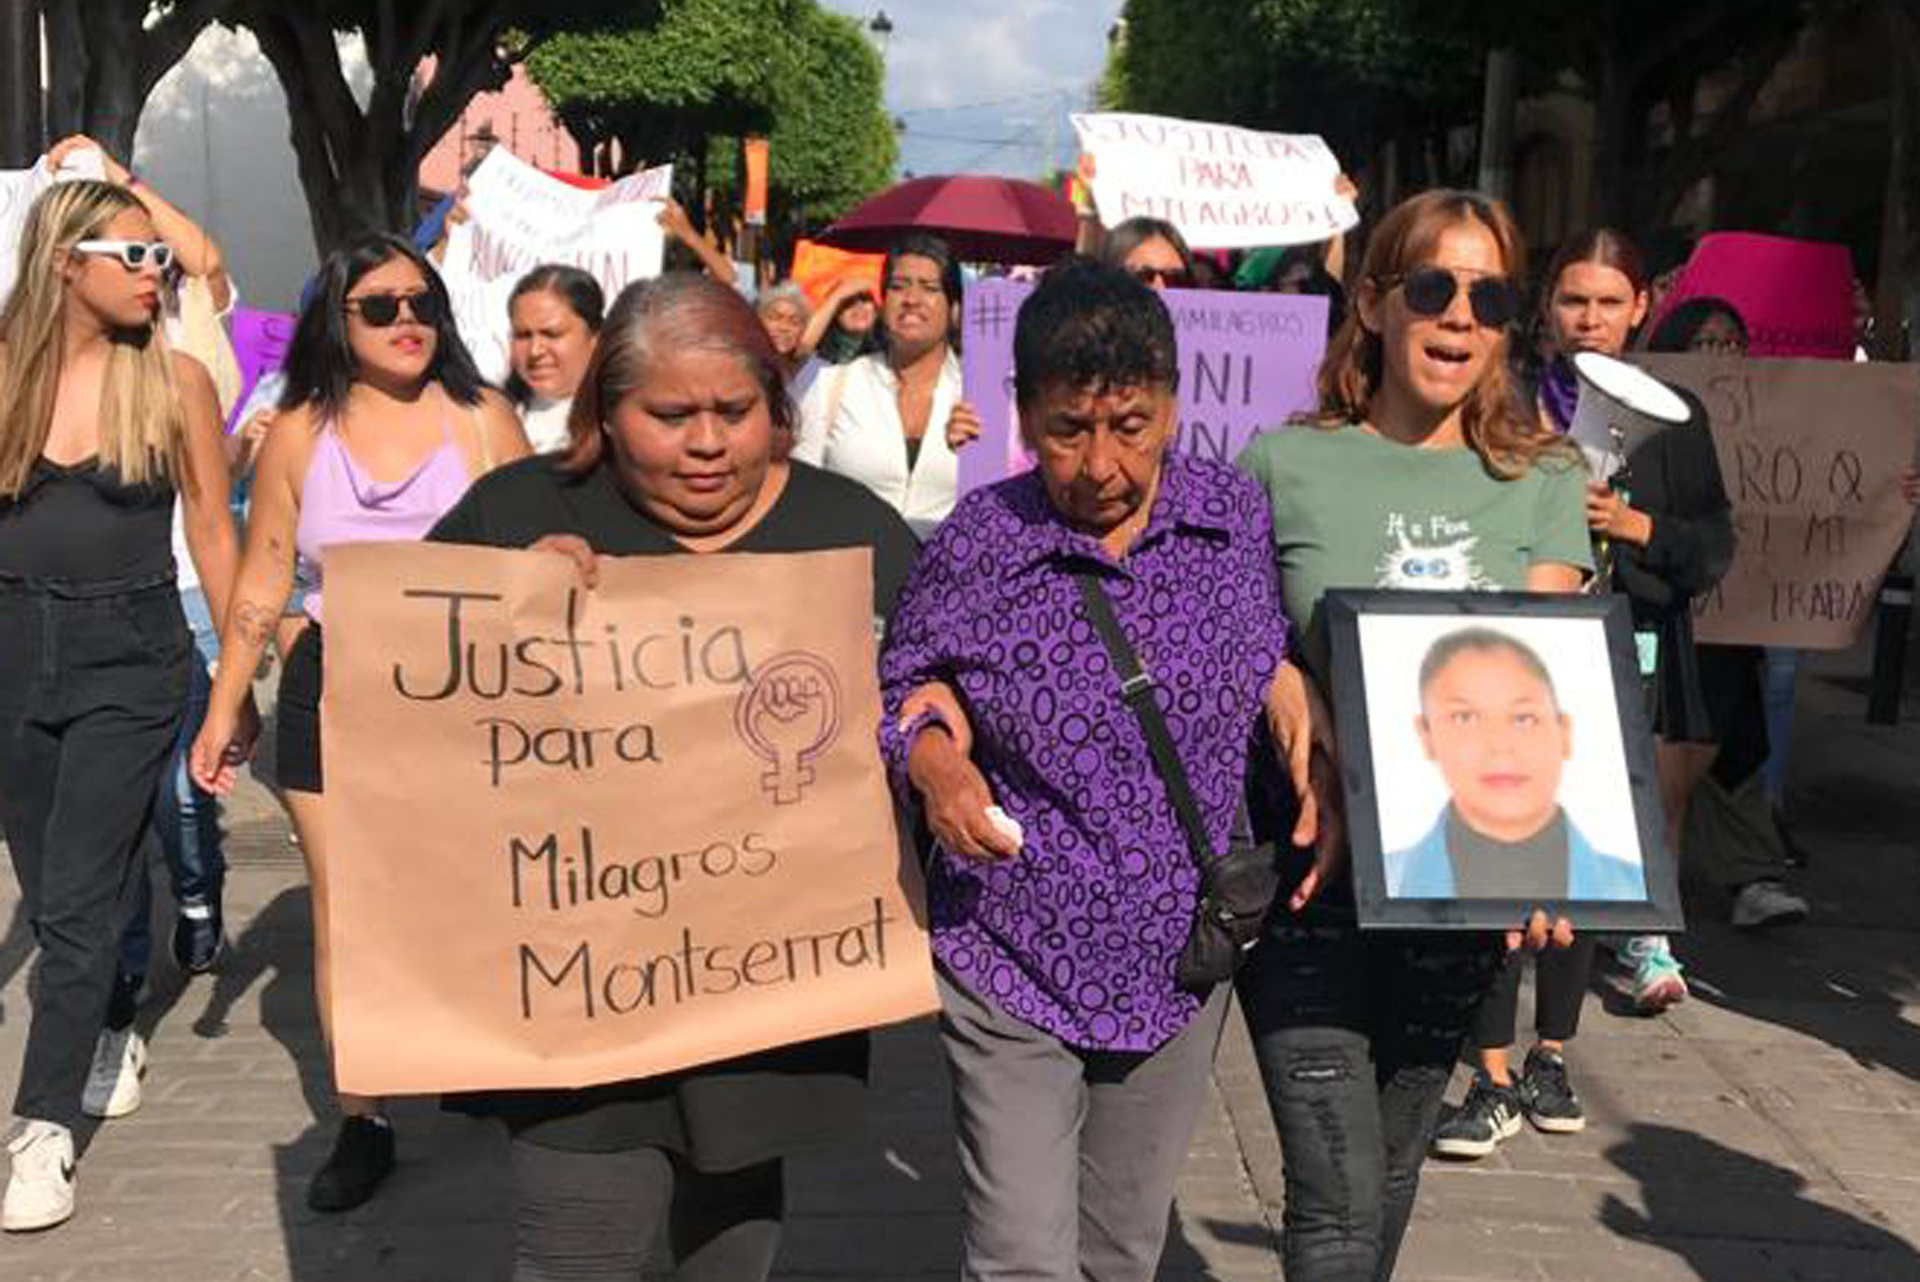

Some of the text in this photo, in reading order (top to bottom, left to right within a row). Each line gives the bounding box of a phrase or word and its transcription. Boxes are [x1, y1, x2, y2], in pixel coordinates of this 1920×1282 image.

[1178, 154, 1254, 190] PARA
[1193, 350, 1253, 406] NI
[392, 586, 757, 701] Justicia
[475, 717, 661, 787] para
[509, 826, 778, 919] Milagros
[517, 897, 897, 1021] Montserrat
